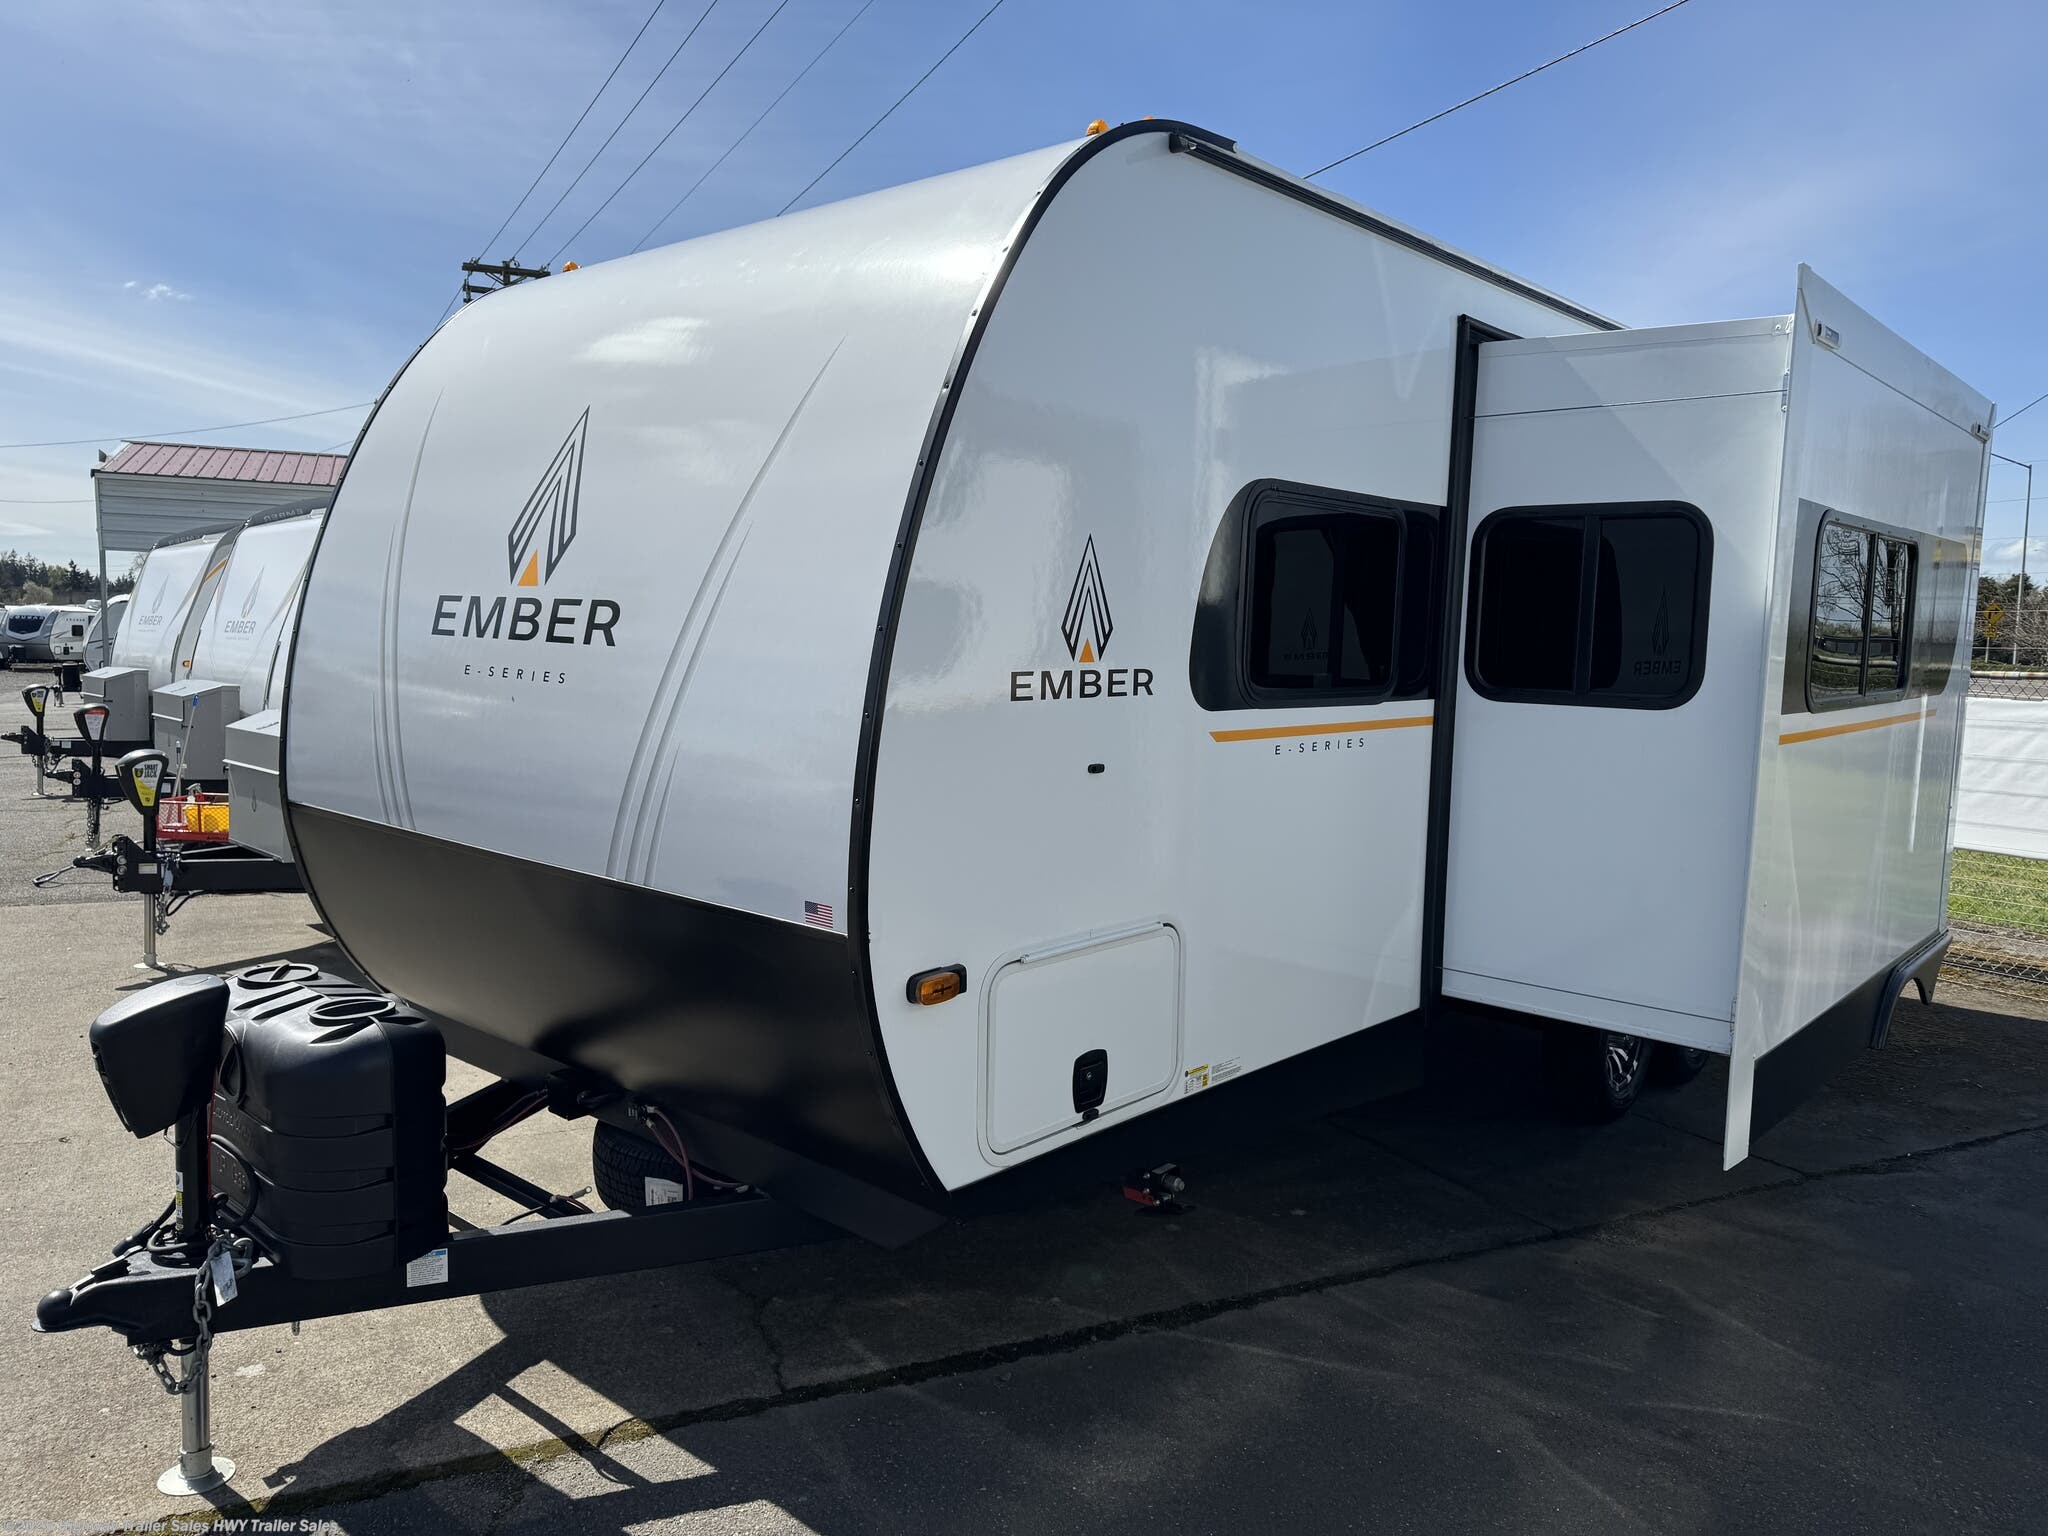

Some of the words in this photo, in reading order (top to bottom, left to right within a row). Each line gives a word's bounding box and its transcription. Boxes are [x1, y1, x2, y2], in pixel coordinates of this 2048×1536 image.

[138, 615, 163, 626] EMBER
[224, 620, 257, 634] EMBER
[431, 594, 621, 647] EMBER
[464, 664, 567, 685] E-SERIES
[1010, 668, 1154, 702] EMBER
[1274, 737, 1365, 756] E-SERIES
